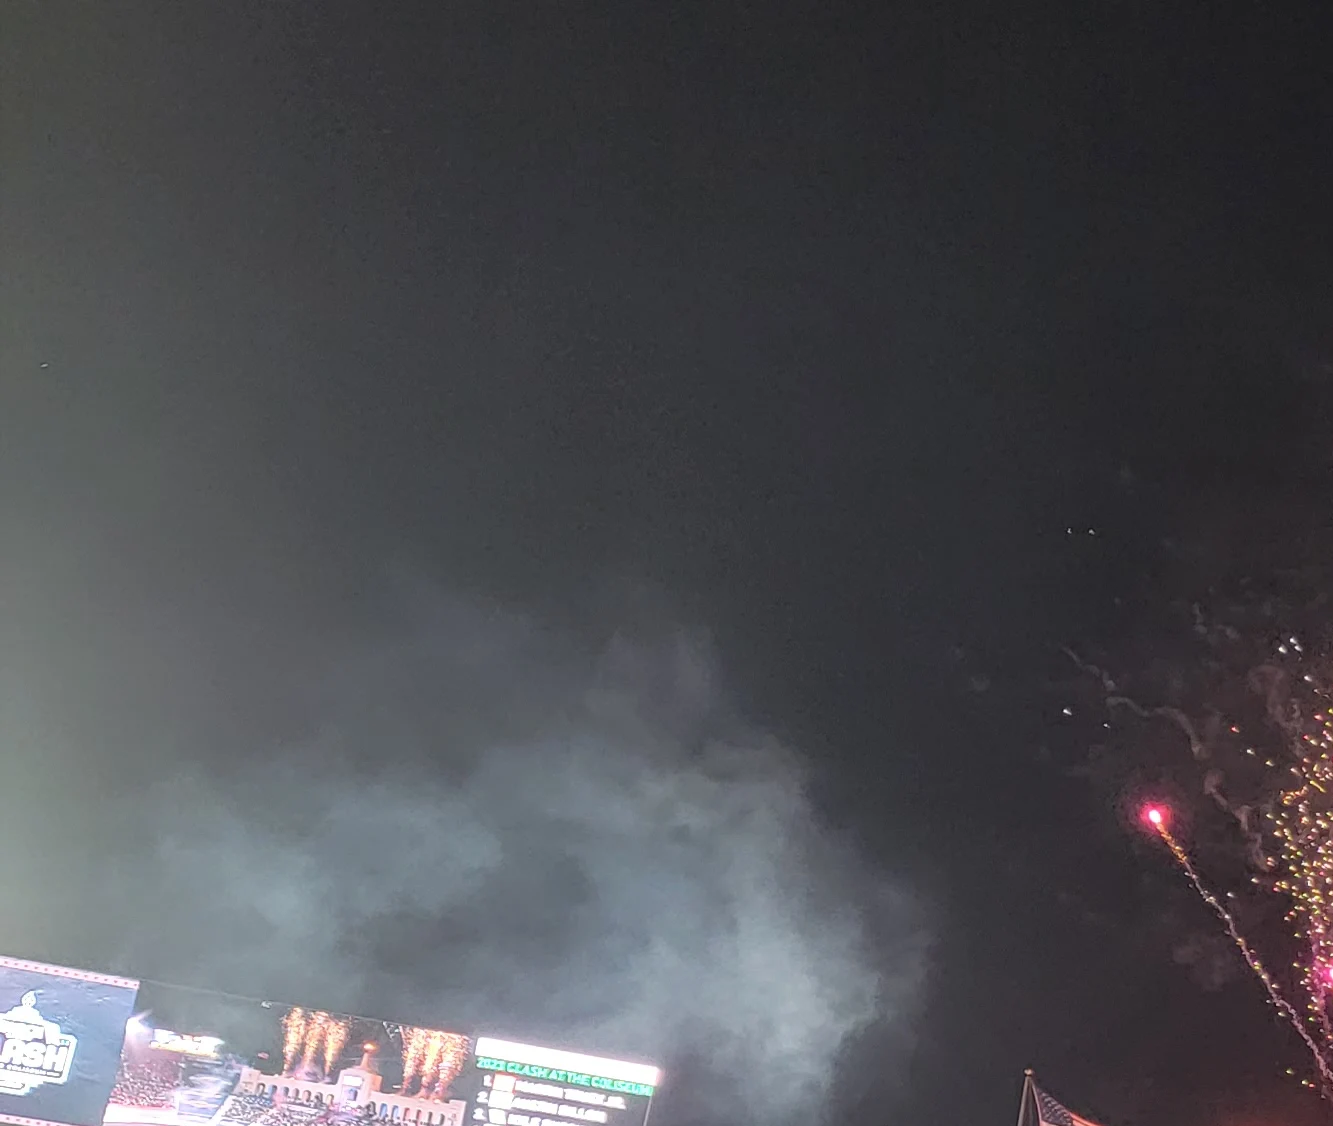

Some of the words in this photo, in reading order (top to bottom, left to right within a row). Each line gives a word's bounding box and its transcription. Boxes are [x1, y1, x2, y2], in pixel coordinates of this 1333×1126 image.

[0, 1037, 70, 1074] ASH
[507, 1061, 547, 1081] CLASH
[567, 1071, 591, 1087] THE
